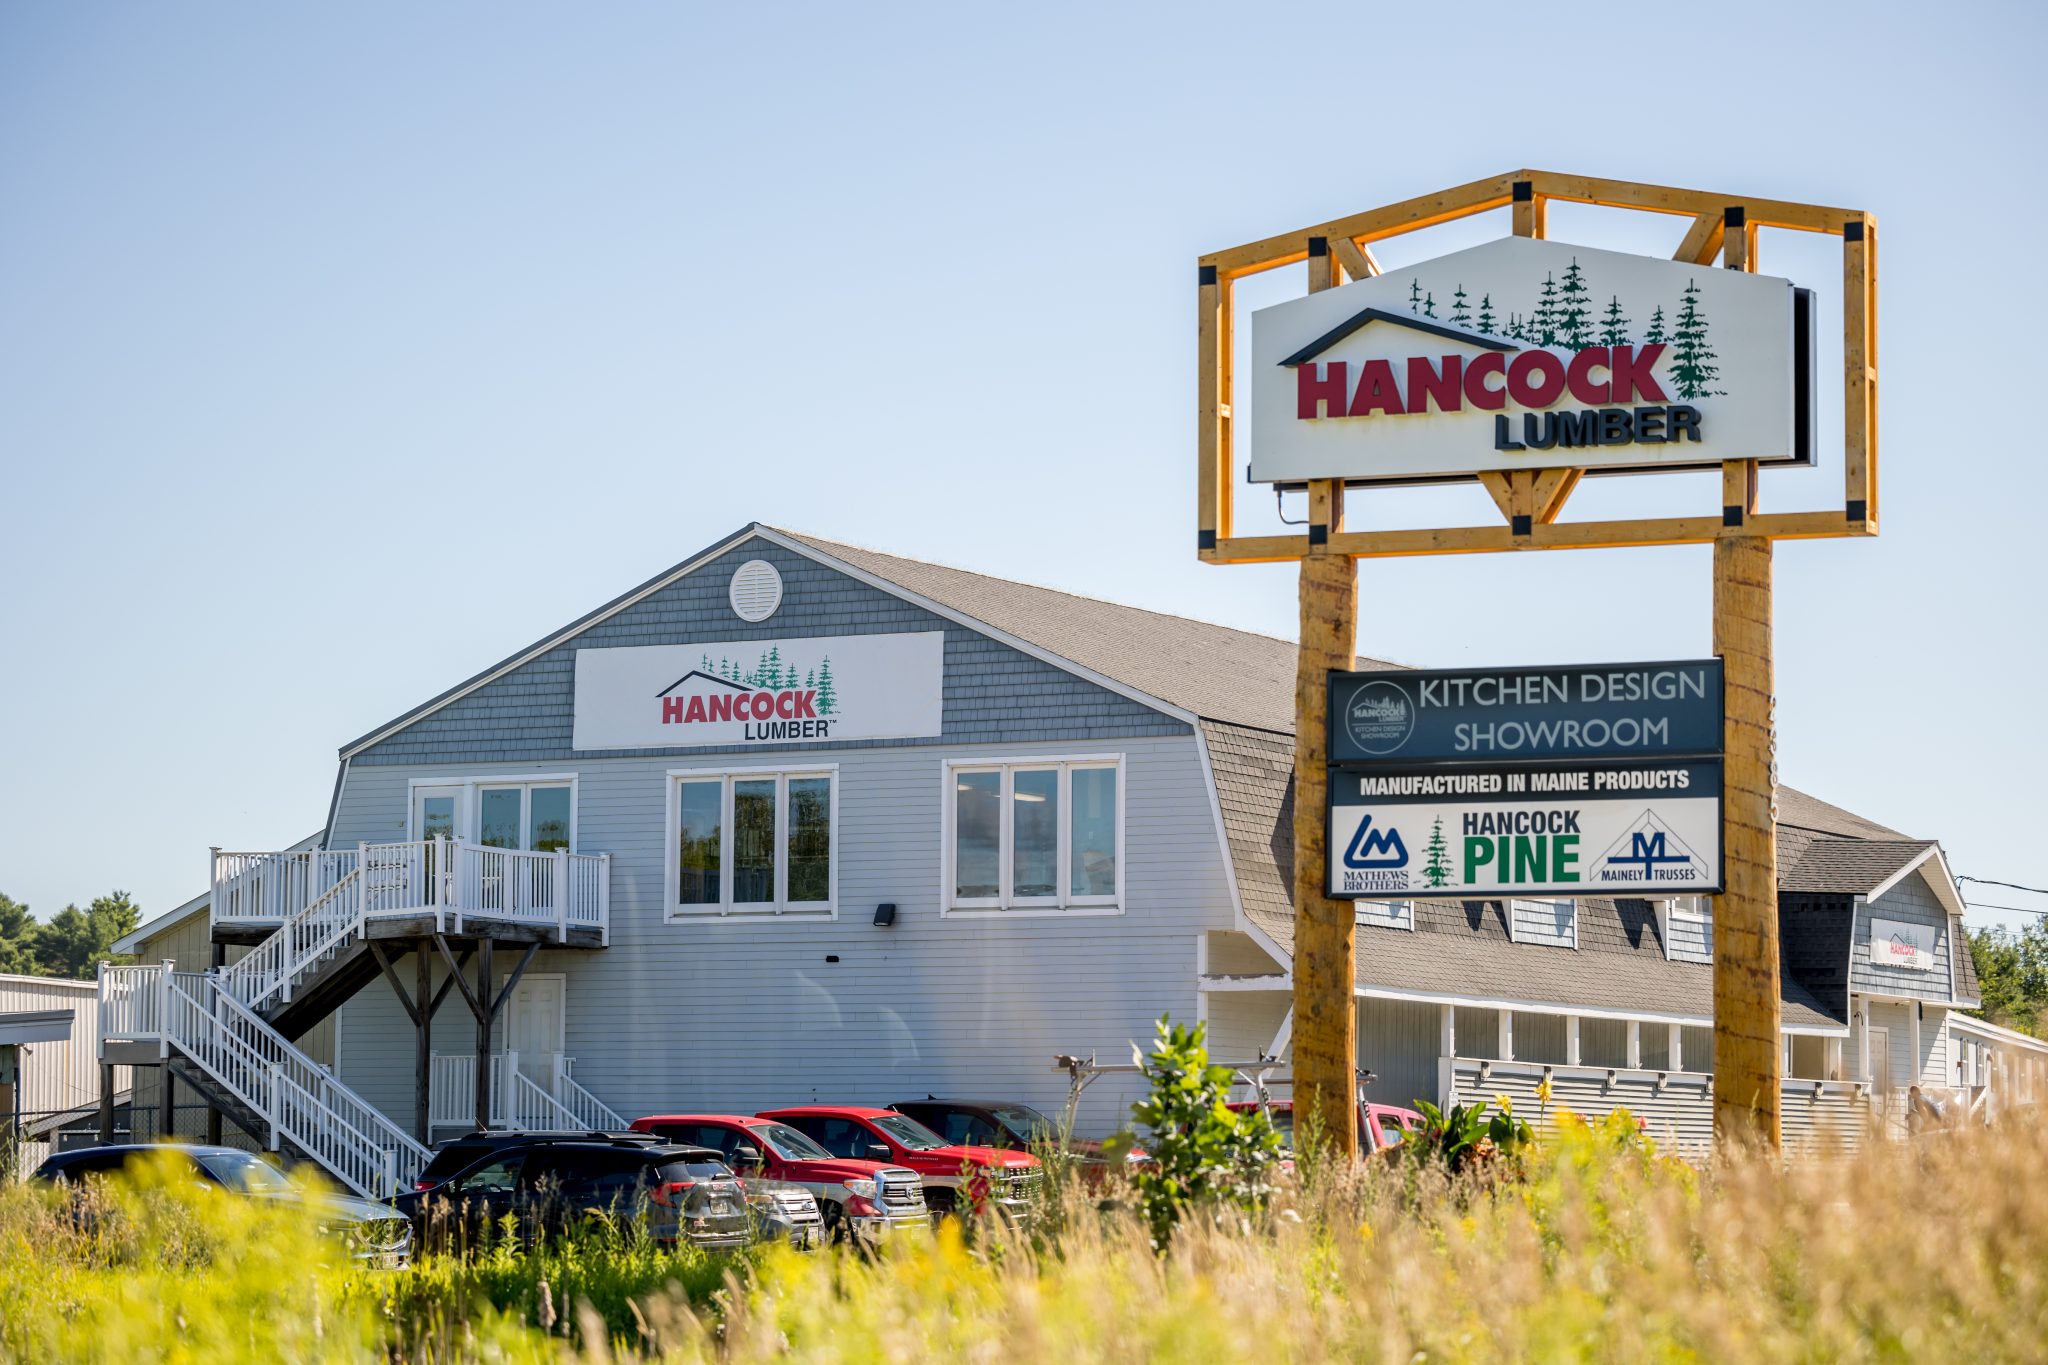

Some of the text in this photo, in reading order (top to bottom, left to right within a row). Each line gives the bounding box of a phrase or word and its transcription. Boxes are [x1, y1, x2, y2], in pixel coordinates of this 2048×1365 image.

[1297, 343, 1672, 420] HANCOCK
[1494, 405, 1702, 451] LUMBER
[1420, 671, 1705, 707] KITCHEN DESIGN
[662, 690, 816, 724] HANCOCK
[1454, 717, 1668, 752] SHOWROOM
[1360, 769, 1690, 796] MANUFACTURED IN MAINE PRODUCTS
[1463, 810, 1581, 835] HANCOCK
[1344, 871, 1409, 881] MATHEWS
[1463, 835, 1580, 884] PINE
[1601, 868, 1696, 881] MAINELY TRUSSES
[1344, 880, 1409, 891] BROTHERS
